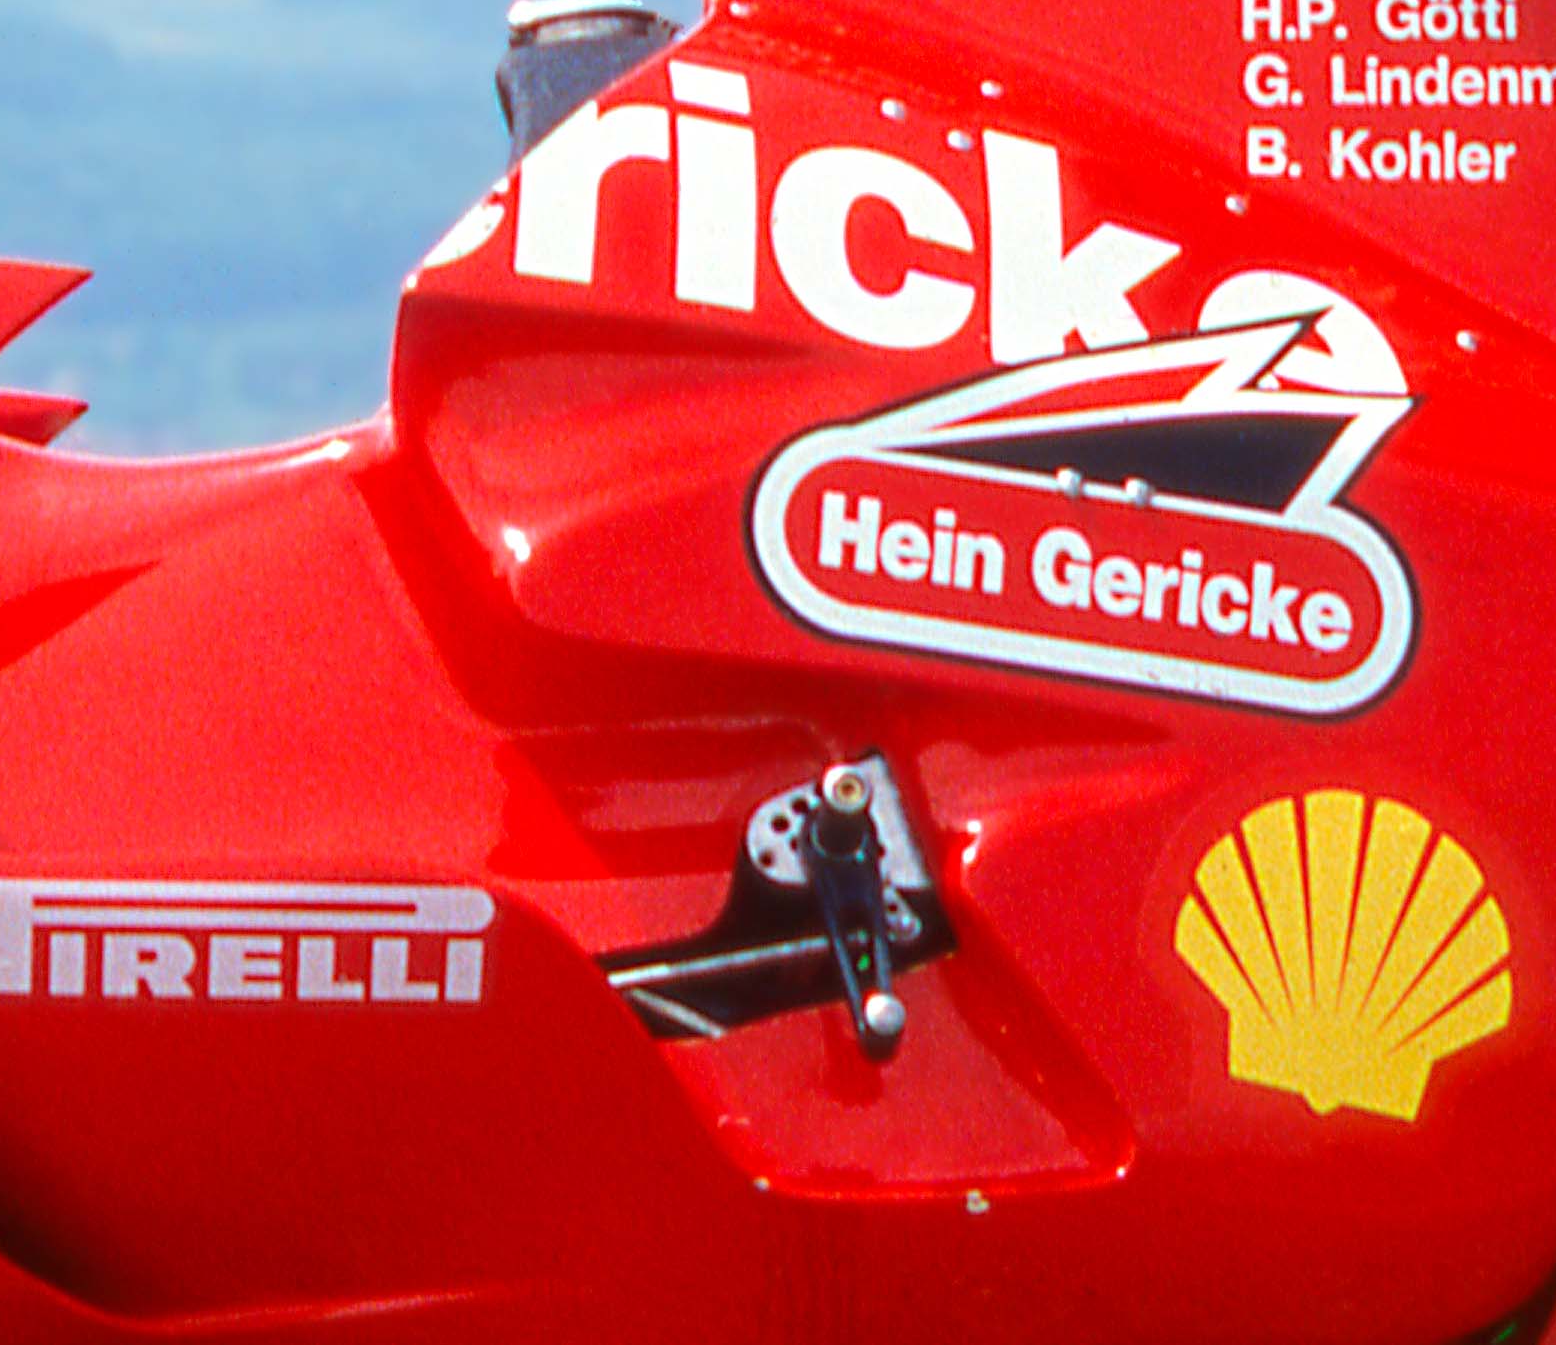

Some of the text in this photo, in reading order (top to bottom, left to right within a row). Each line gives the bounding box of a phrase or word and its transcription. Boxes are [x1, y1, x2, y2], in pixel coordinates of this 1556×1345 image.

[1243, 52, 1304, 108] G.
[1246, 126, 1518, 182] B. Kohler
[816, 491, 1355, 653] Hein Gericke
